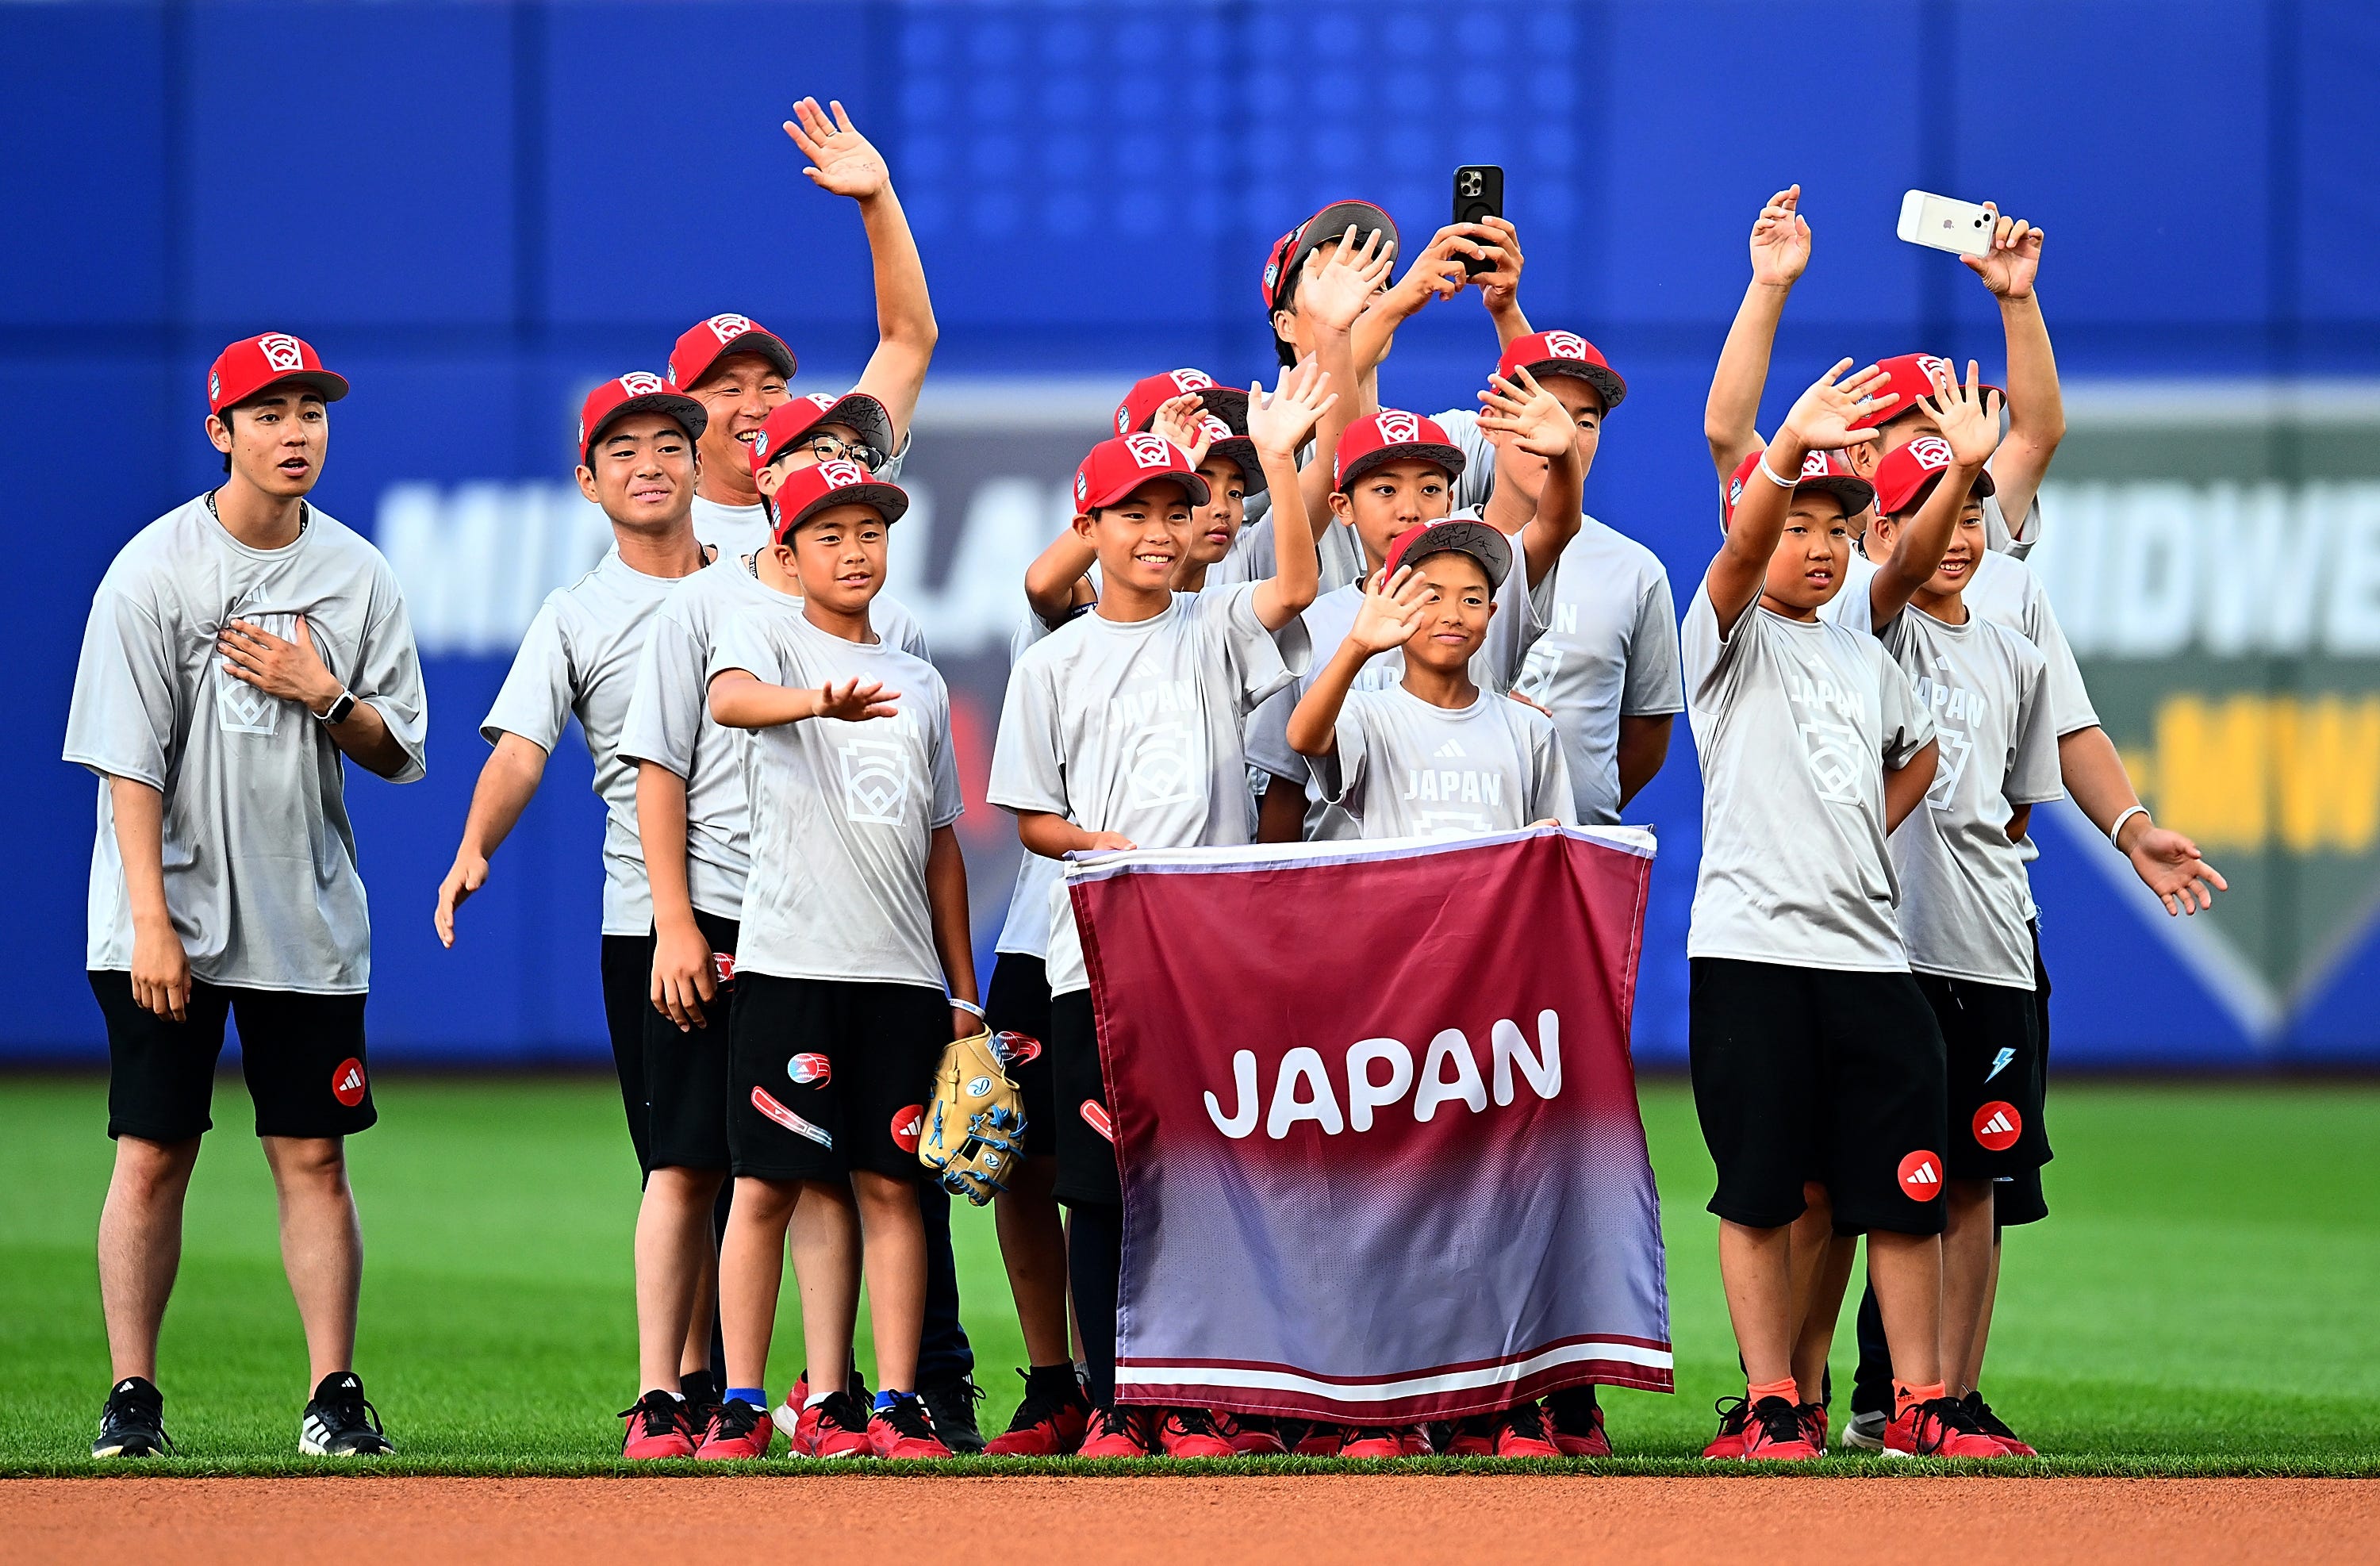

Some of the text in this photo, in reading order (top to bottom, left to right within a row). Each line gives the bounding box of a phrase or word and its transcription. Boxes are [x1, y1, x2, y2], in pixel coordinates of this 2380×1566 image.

[1108, 678, 1198, 731] JAPAN
[1791, 675, 1865, 724] JAPAN
[1404, 769, 1501, 806] JAPAN
[1204, 1009, 1560, 1139] JAPAN
